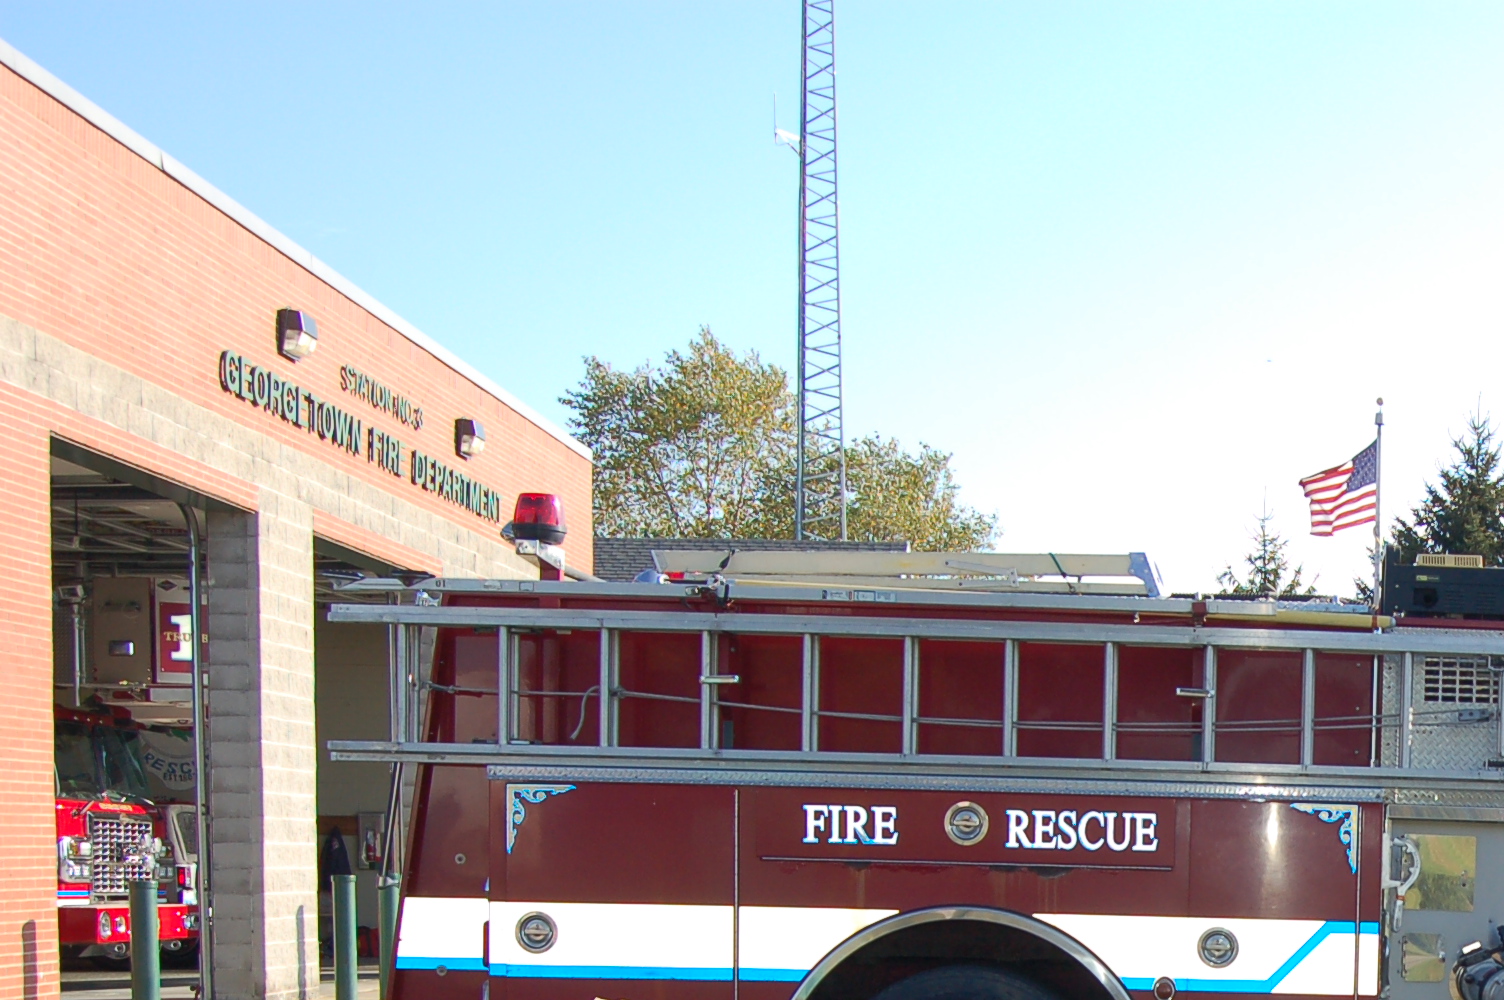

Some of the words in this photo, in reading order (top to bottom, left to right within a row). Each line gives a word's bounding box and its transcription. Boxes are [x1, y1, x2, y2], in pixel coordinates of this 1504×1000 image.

[341, 364, 393, 412] STATION
[219, 350, 362, 456] GEORGETOWN
[368, 427, 406, 477] FIRE
[411, 450, 503, 523] DEPARTMENT
[802, 804, 899, 845] FIRE
[1005, 809, 1159, 851] RESCUE
